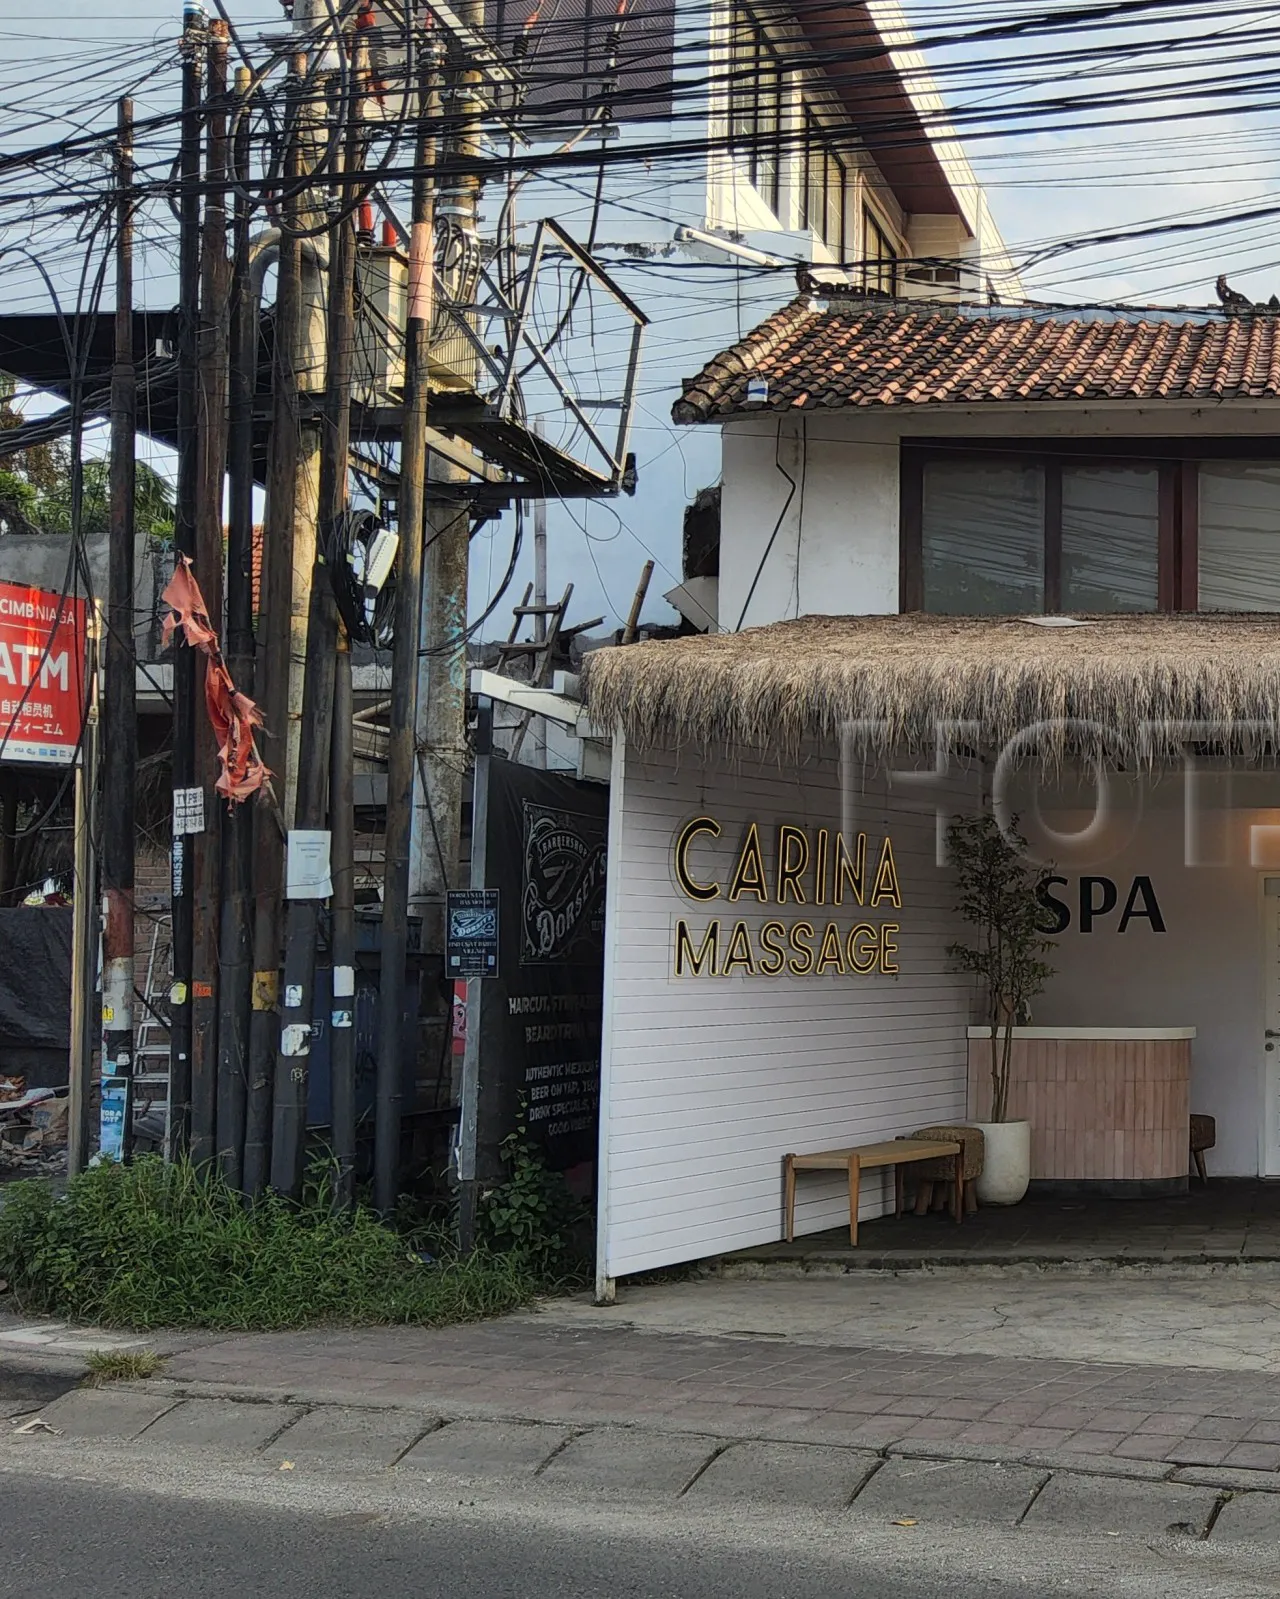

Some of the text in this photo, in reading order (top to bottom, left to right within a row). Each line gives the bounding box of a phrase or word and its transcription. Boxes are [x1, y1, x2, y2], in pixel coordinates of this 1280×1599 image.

[0, 598, 34, 618] CIMB
[542, 835, 588, 857] BARBERSHOP
[675, 817, 902, 908] CARINA
[1034, 875, 1167, 934] SPA
[675, 919, 899, 976] MASSAGE
[525, 1065, 564, 1082] AUTHENTIC
[531, 1086, 549, 1100] BEER
[529, 1107, 551, 1122] DRINK
